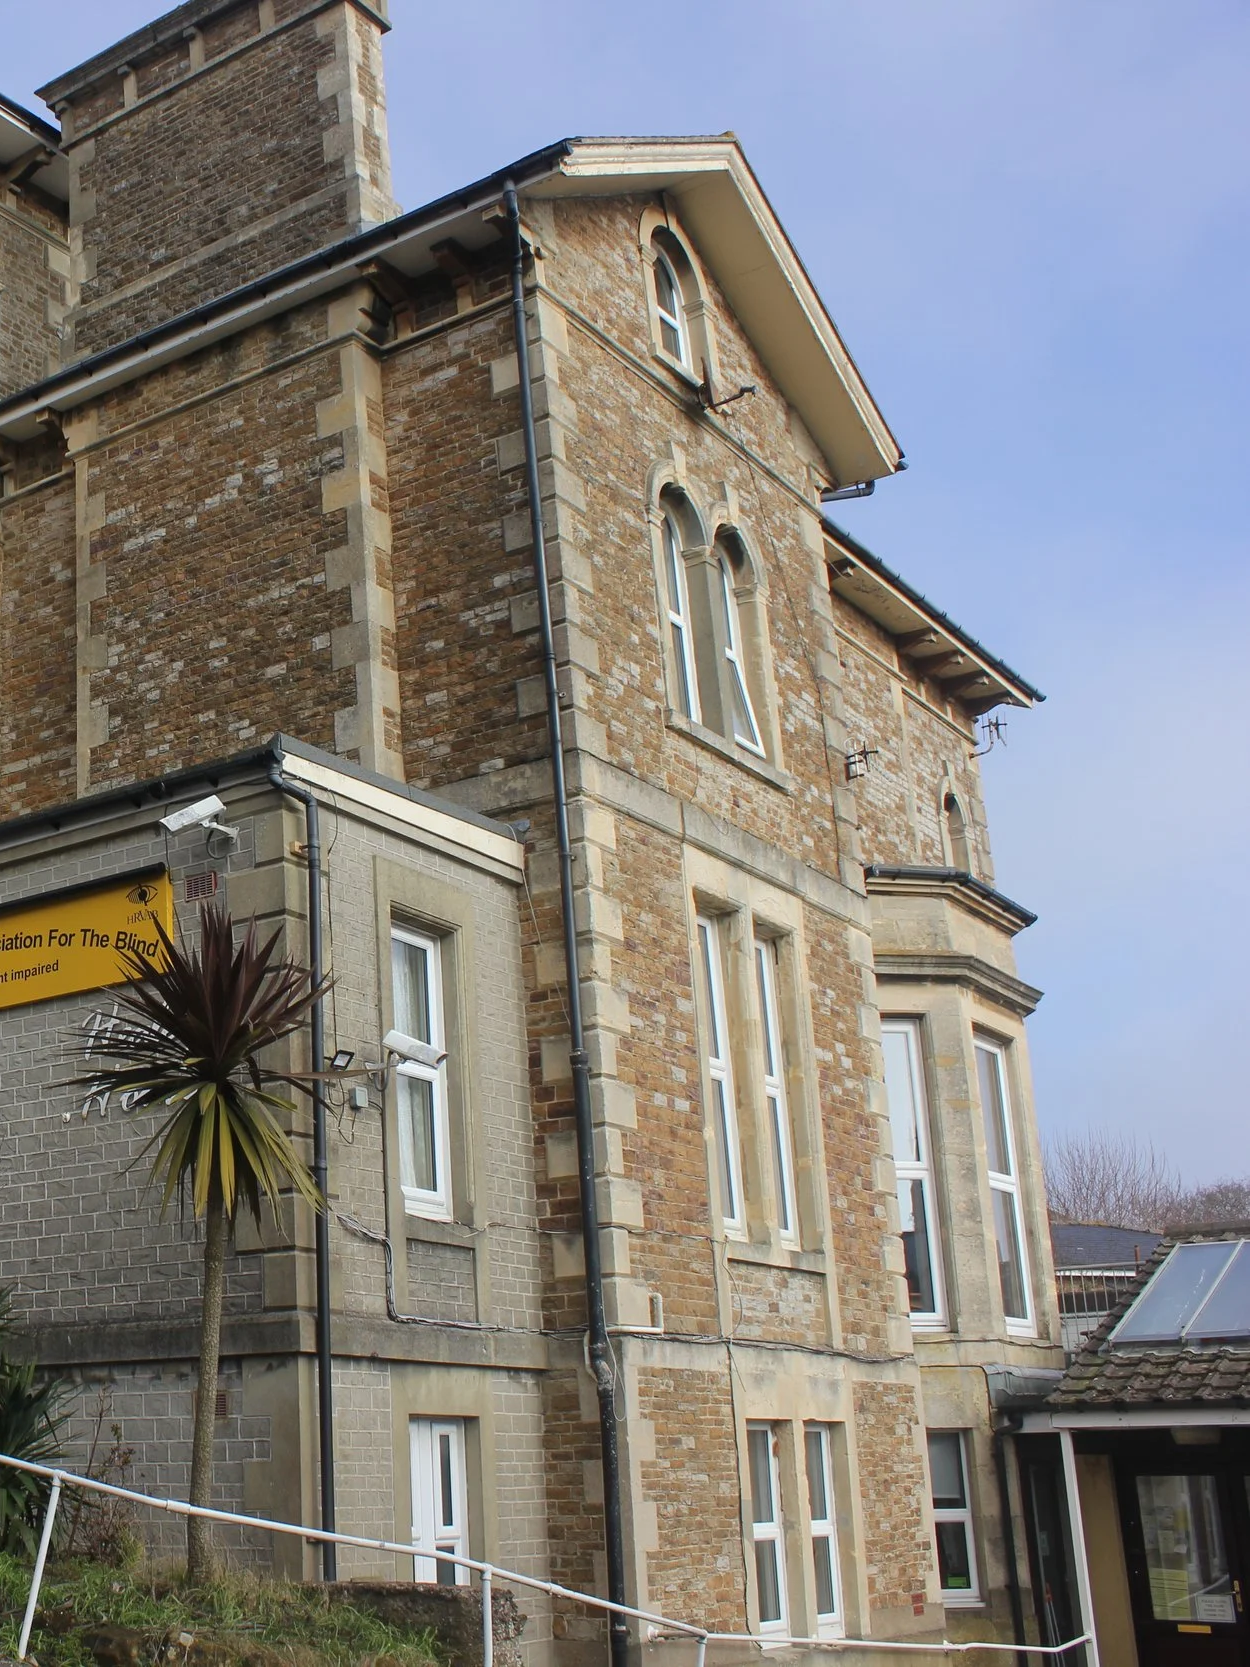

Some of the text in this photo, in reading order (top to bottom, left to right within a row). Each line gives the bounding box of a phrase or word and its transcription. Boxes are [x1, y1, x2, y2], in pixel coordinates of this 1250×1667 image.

[48, 929, 75, 948] For
[80, 928, 110, 948] The
[115, 930, 159, 957] Blind
[11, 960, 59, 982] impaired
